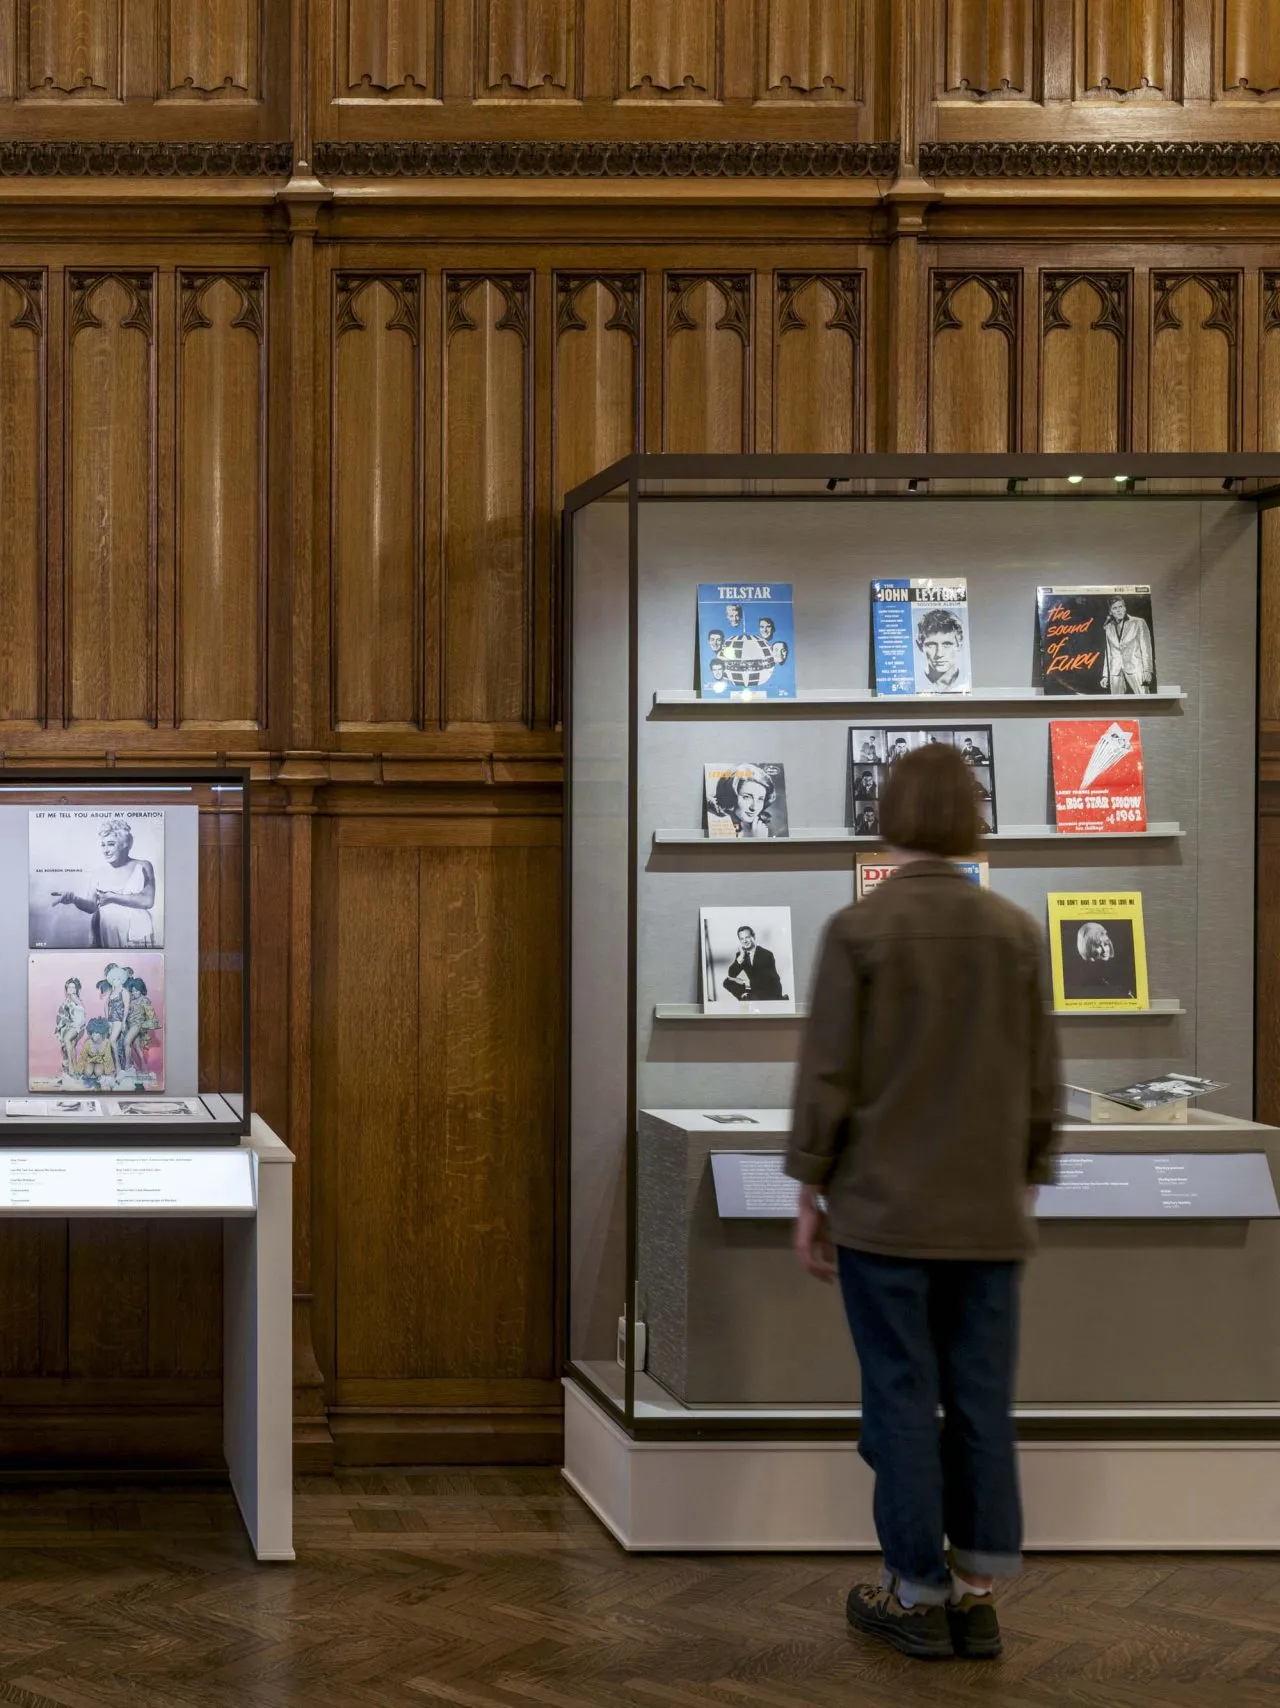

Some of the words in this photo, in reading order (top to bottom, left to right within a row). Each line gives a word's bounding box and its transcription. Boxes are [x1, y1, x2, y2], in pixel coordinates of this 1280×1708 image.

[717, 586, 772, 599] TELSTAR
[880, 588, 909, 602] JOHN
[1047, 603, 1072, 622] the
[1046, 616, 1094, 638] sound
[1047, 637, 1069, 658] of
[1065, 797, 1084, 809] BIG
[1085, 796, 1109, 809] STAR
[1111, 796, 1142, 809] SHOW
[1115, 809, 1142, 822] 1962
